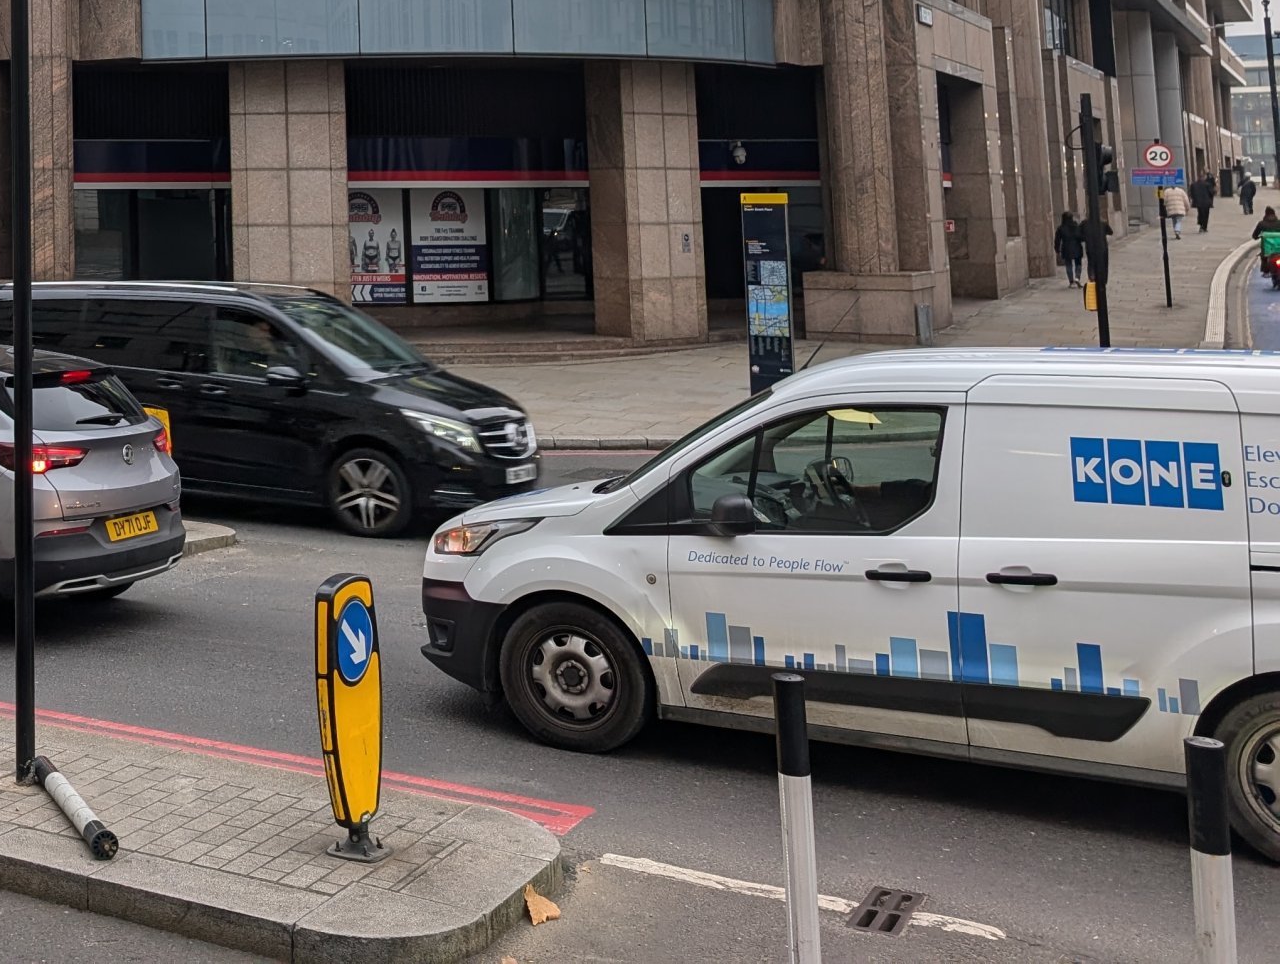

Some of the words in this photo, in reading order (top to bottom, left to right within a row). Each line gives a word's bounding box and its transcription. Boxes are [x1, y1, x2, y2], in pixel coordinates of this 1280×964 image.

[1149, 150, 1169, 161] 20
[1075, 457, 1217, 490] KONE
[113, 518, 136, 537] DY71
[135, 515, 151, 531] OJF
[688, 550, 749, 566] Dedicated
[752, 556, 765, 567] to
[769, 556, 810, 573] People
